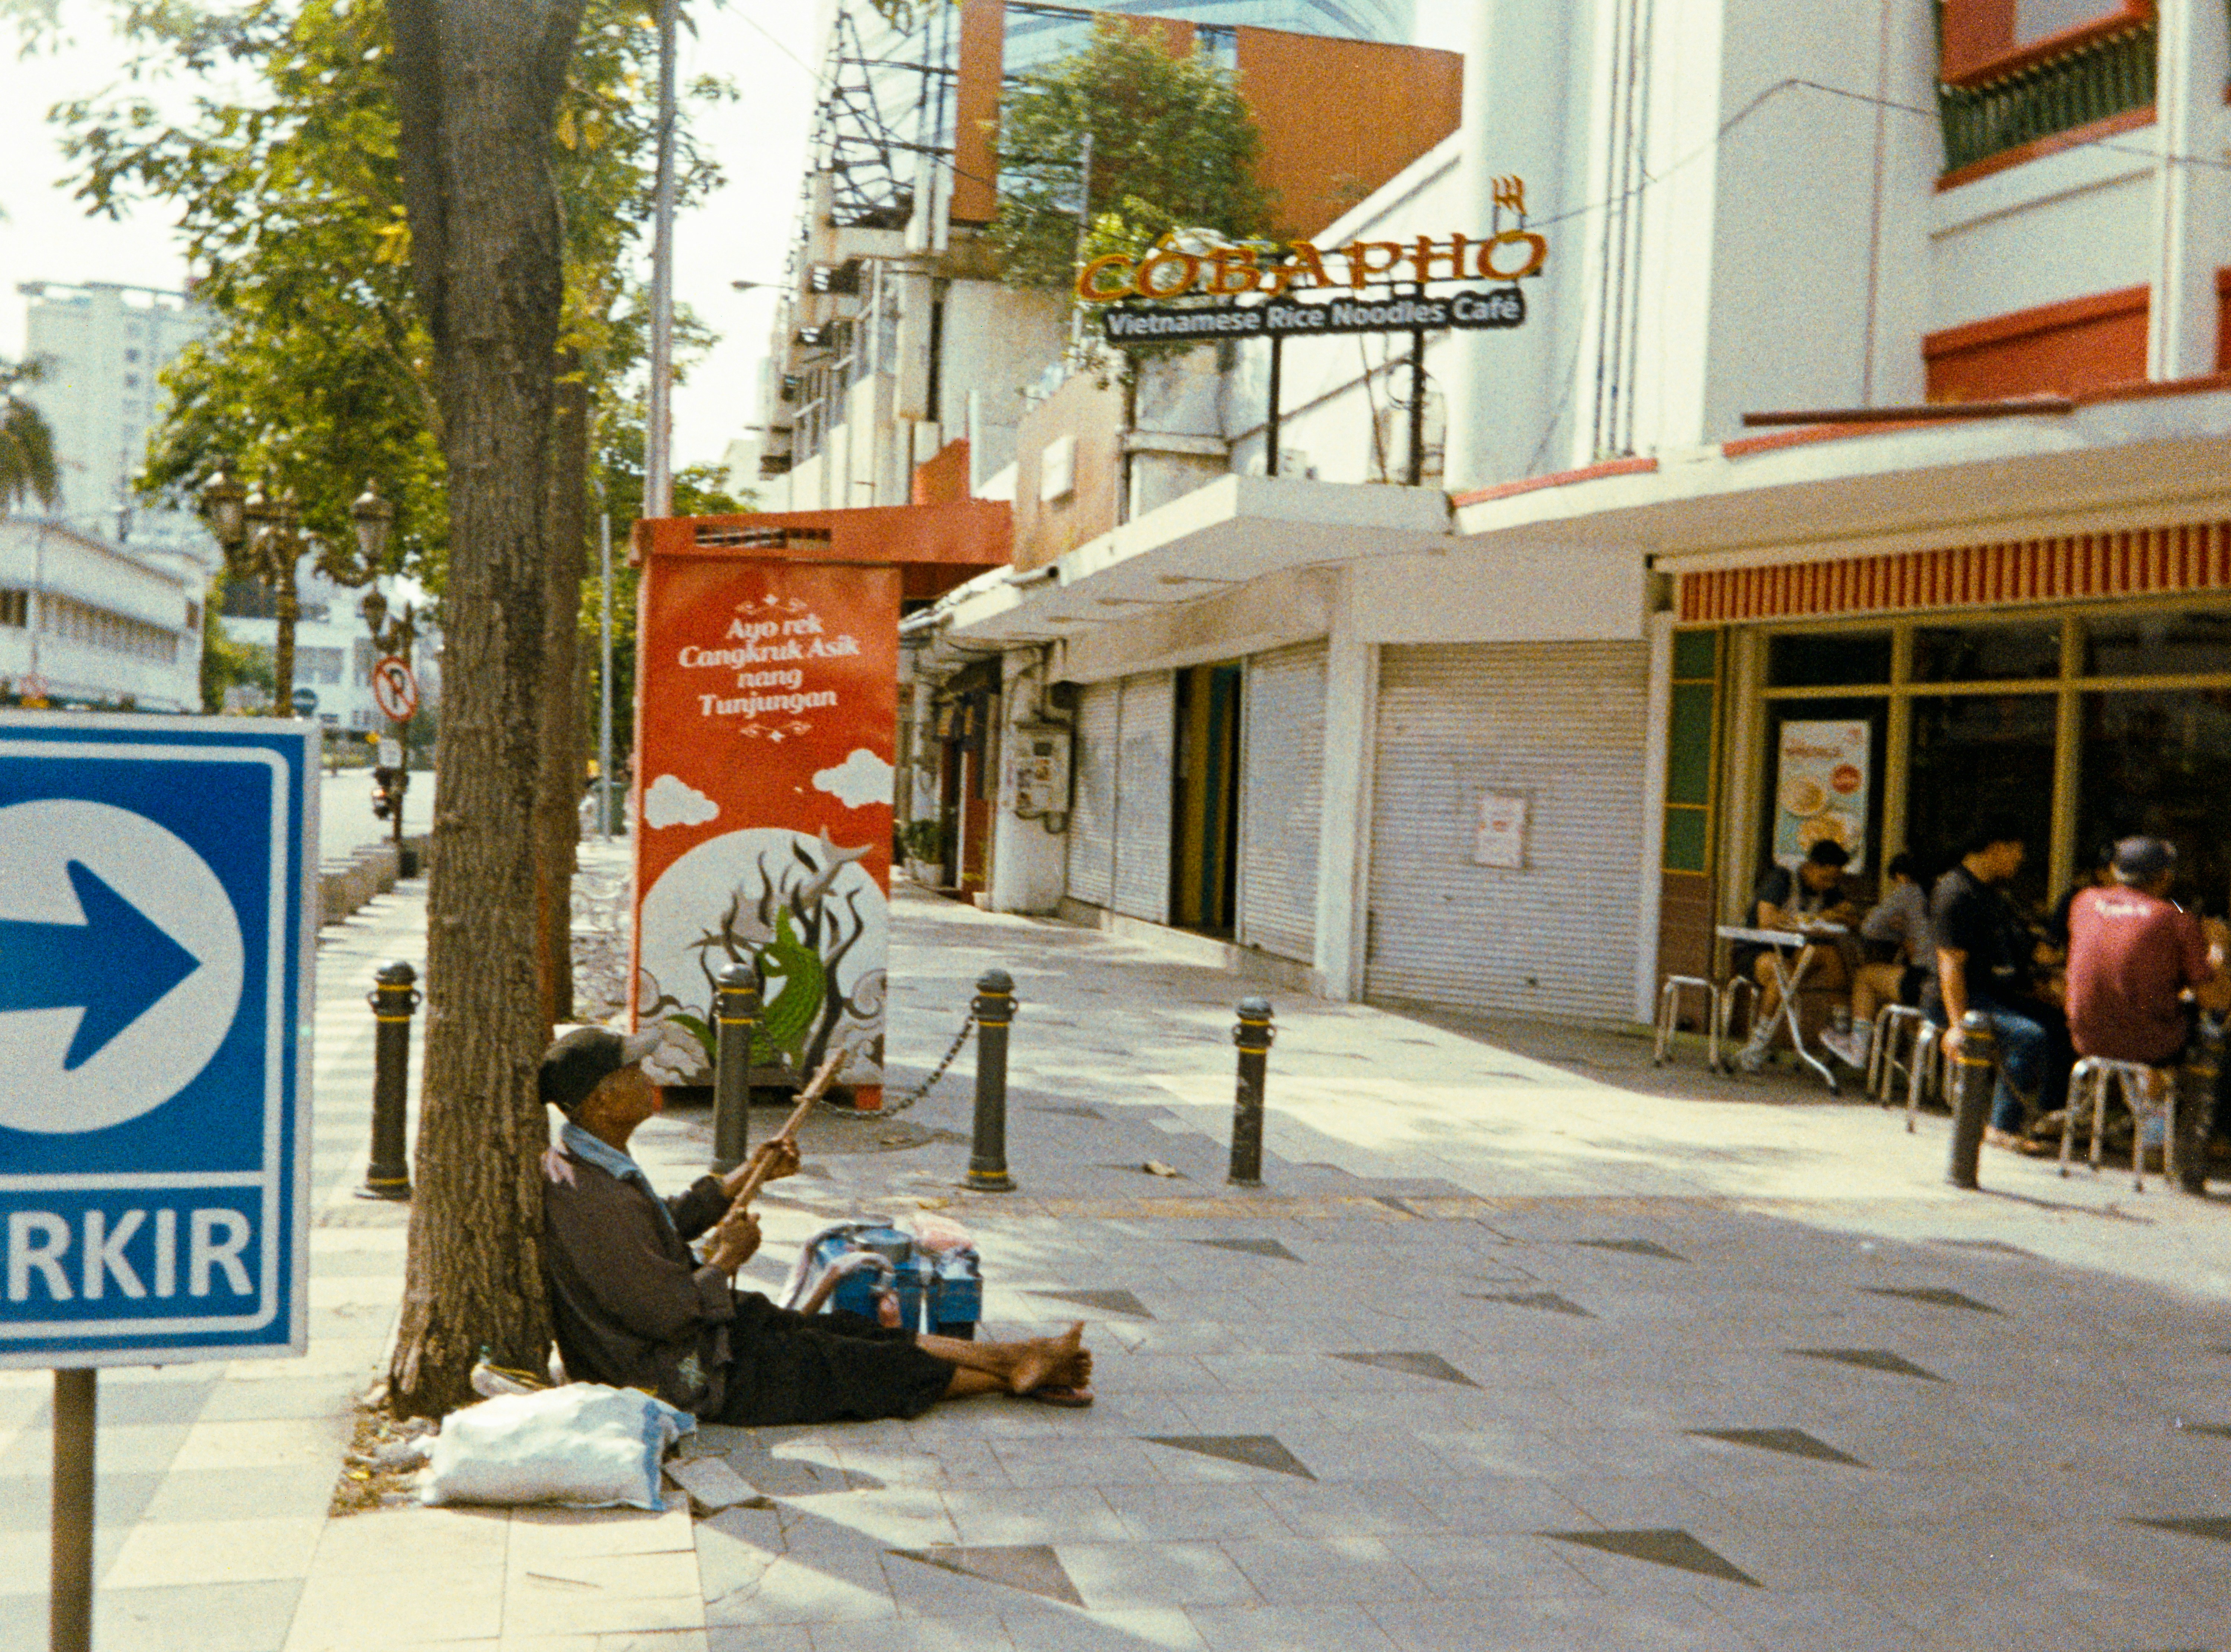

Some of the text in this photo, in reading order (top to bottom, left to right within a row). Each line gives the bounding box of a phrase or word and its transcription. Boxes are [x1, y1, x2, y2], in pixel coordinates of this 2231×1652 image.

[1107, 295, 1520, 334] Vietnamese Rice Noodles Café
[726, 613, 824, 643] Ayo rek
[679, 635, 860, 669] Cangkruk Asik
[738, 669, 802, 690] nang
[698, 690, 838, 719] Tunjungan
